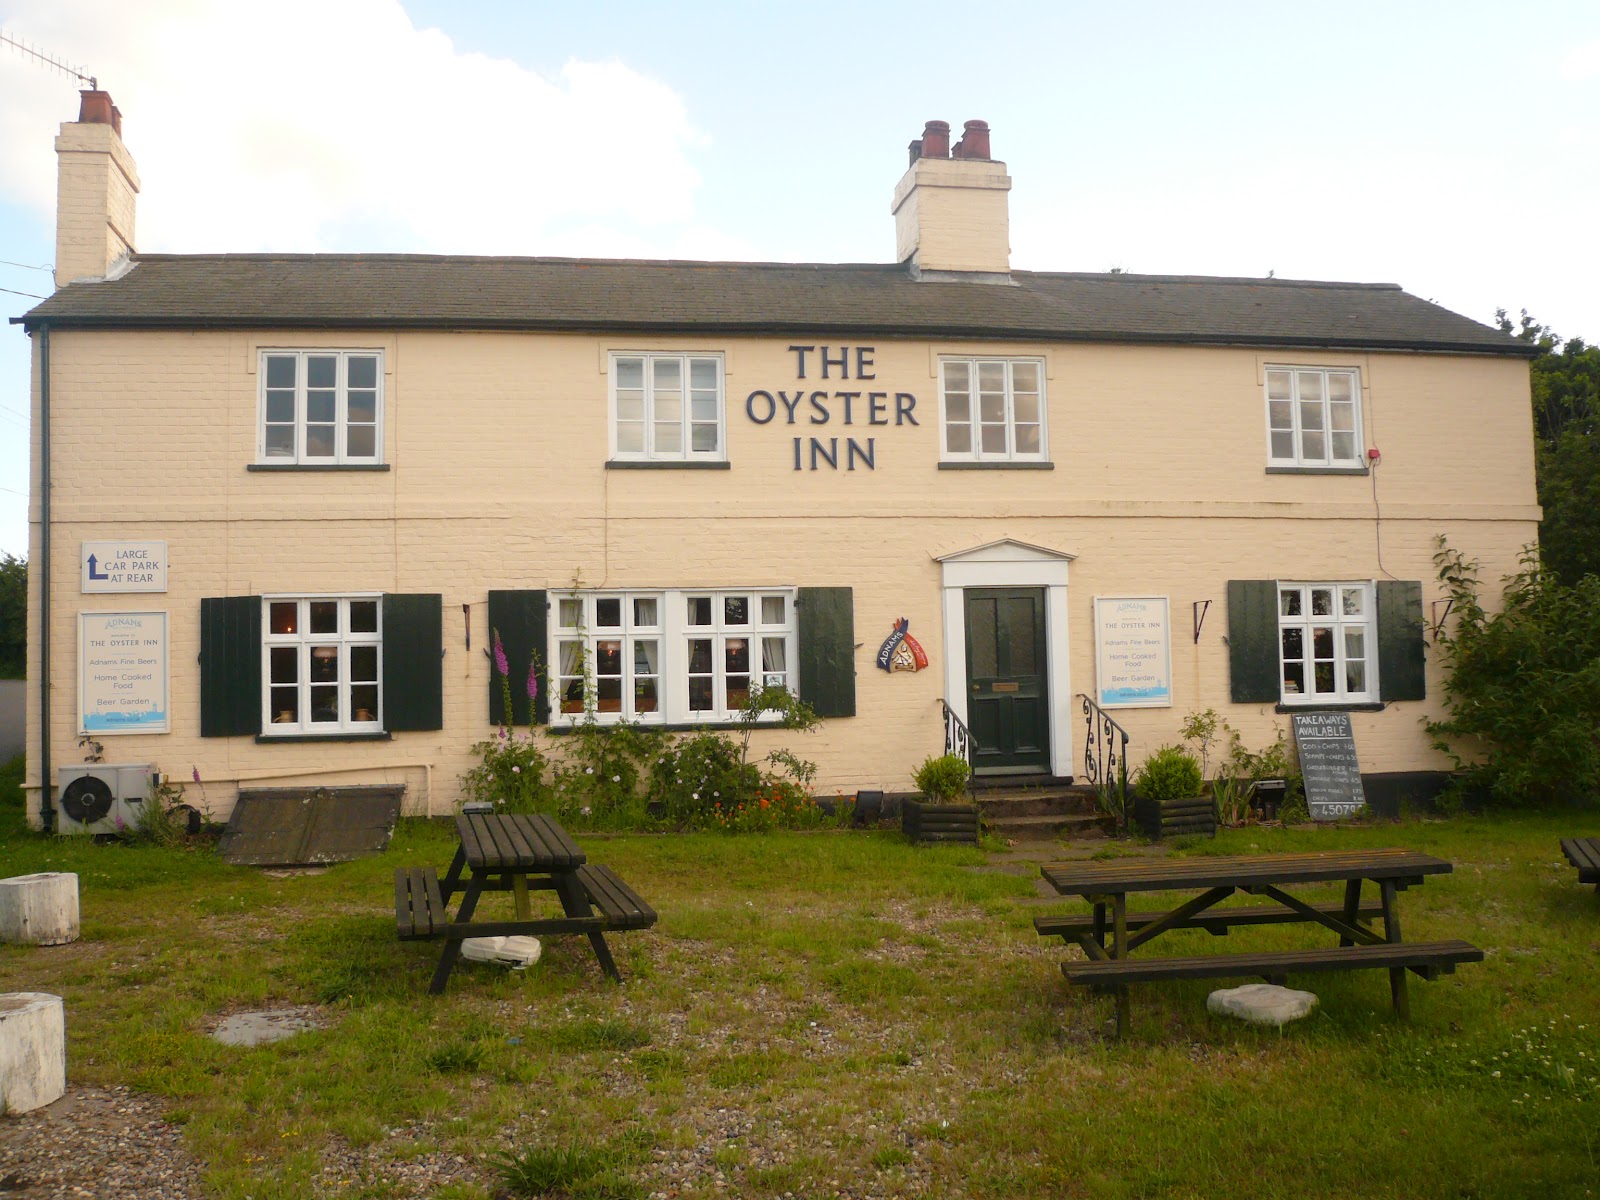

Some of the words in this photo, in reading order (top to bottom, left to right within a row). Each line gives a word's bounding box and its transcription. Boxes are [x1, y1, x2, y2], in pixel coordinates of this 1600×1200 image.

[788, 345, 876, 380] THE
[746, 389, 920, 426] OYSTER
[793, 437, 875, 471] INN
[116, 550, 148, 559] LARGE
[104, 562, 126, 571] CAR
[132, 561, 159, 570] PARK
[110, 574, 124, 583] AT
[127, 574, 154, 583] REAR
[104, 618, 143, 630] ADNAMS
[880, 632, 904, 666] ADNAMS
[1295, 715, 1348, 725] TAKEAWAYS
[1298, 726, 1346, 736] AVAILABLE
[1321, 804, 1362, 816] 45079
